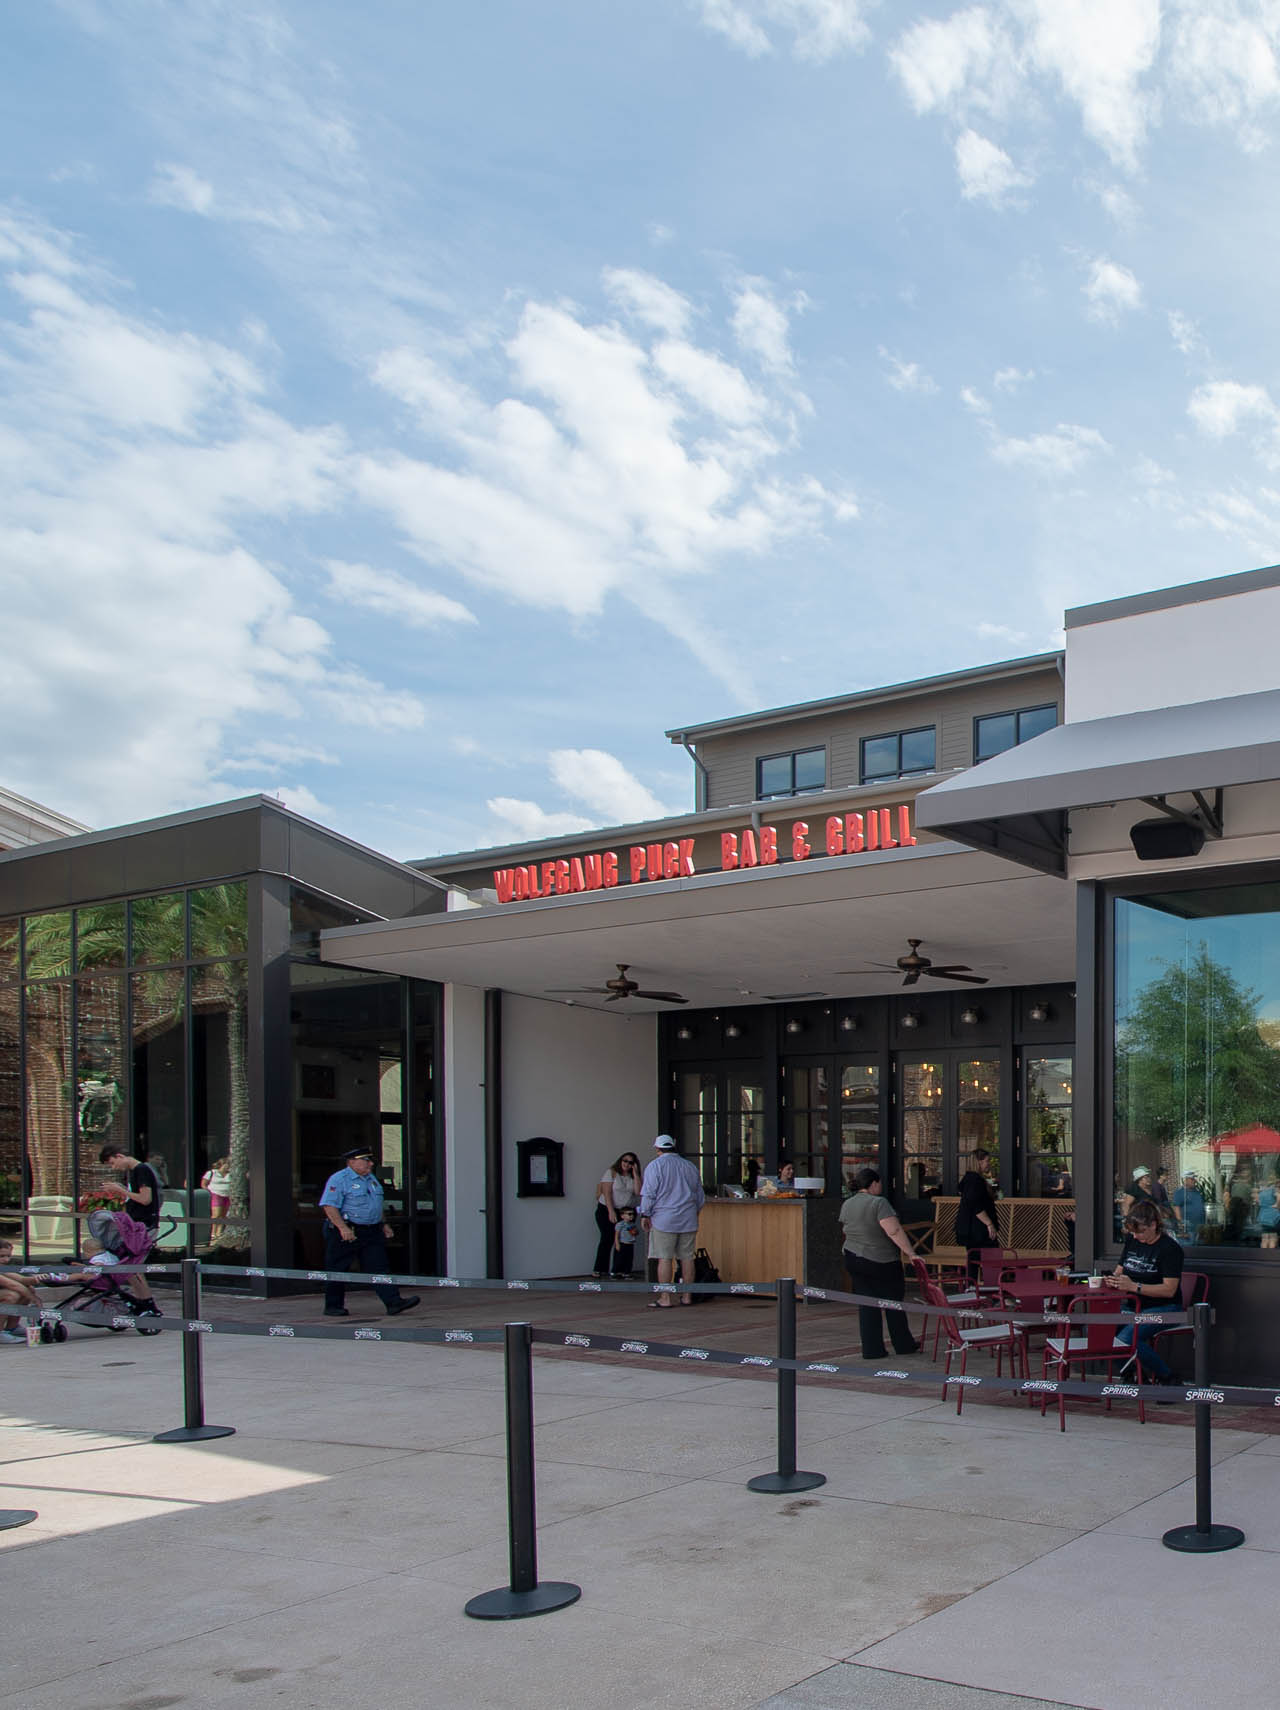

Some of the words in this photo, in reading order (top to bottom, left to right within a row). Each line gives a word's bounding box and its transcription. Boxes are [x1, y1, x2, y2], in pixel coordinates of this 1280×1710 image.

[493, 851, 618, 904] WOLFGANG
[630, 838, 695, 884] PUCK
[721, 826, 778, 871] BAR
[792, 821, 811, 861] &
[826, 805, 917, 857] GRILL
[1134, 1315, 1163, 1324] SPRINGS
[445, 1332, 474, 1343] SPRINGS
[564, 1335, 591, 1348] SPRINGS
[620, 1342, 649, 1354] SPRINGS
[678, 1349, 710, 1360] SPRINGS
[740, 1356, 773, 1366] SPRINGS
[806, 1363, 839, 1373] SPRINGS
[874, 1370, 910, 1379] SPRINGS
[945, 1376, 982, 1386] SPRINGS
[1021, 1381, 1059, 1392] SPRINGS
[1101, 1386, 1139, 1397] SPRINGS
[1185, 1391, 1225, 1403] SPRINGS
